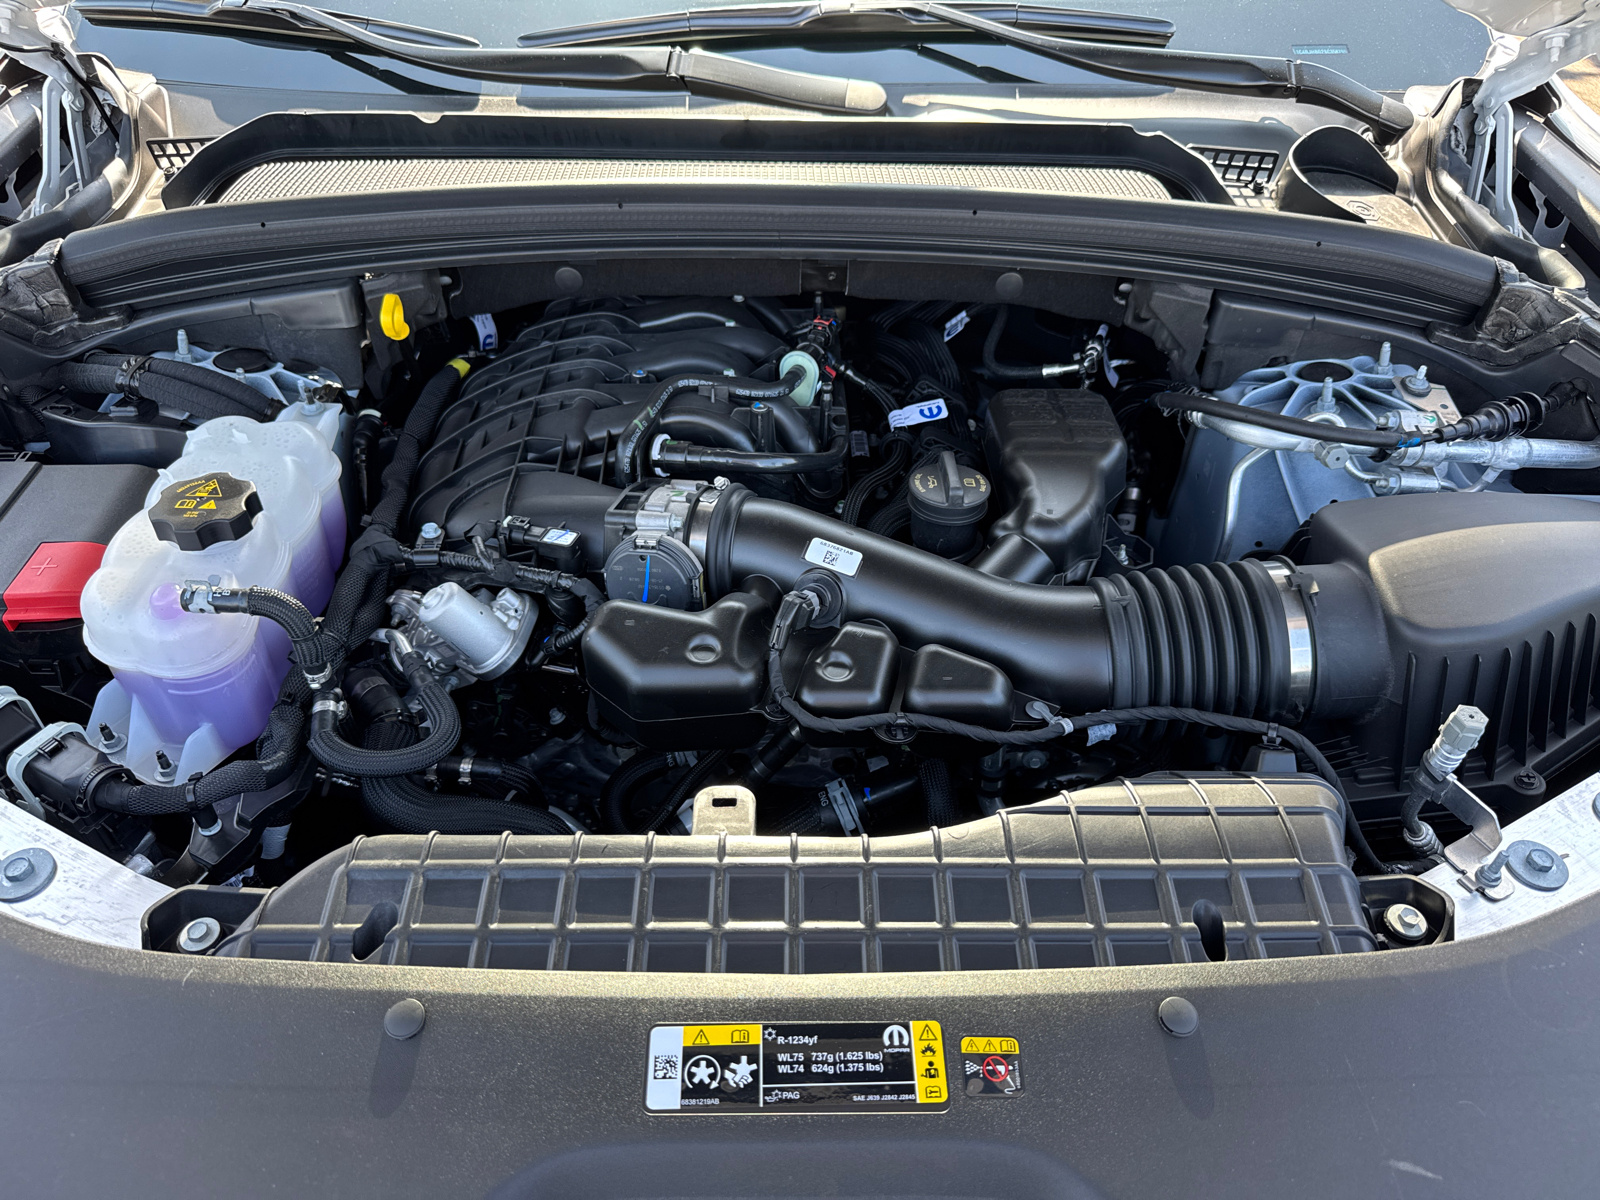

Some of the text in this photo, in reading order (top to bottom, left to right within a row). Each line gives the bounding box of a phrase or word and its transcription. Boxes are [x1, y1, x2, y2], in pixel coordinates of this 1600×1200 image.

[817, 790, 829, 807] ENG
[777, 1035, 818, 1046] R-1234yf
[777, 1051, 883, 1063] WL75 737g (1.625 lbs)
[777, 1062, 884, 1074] WL74 624g (1.375 lbs)
[782, 1091, 800, 1099] PAG
